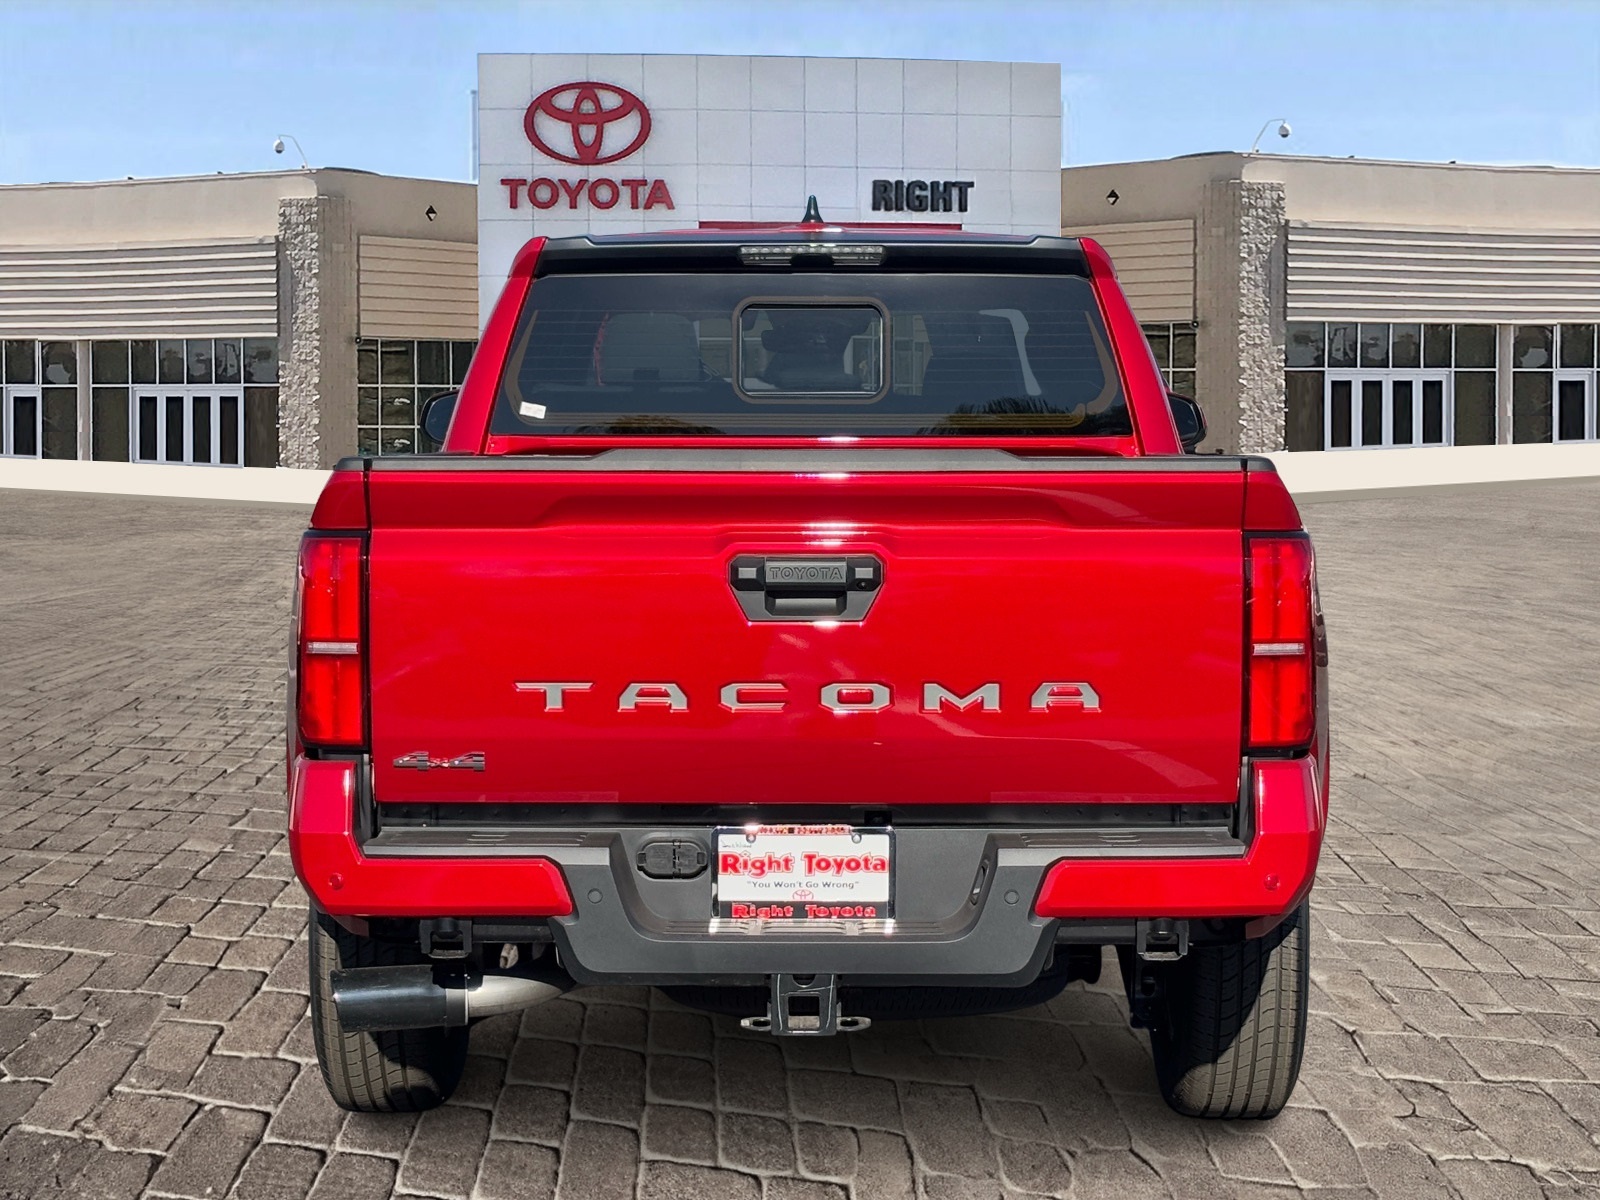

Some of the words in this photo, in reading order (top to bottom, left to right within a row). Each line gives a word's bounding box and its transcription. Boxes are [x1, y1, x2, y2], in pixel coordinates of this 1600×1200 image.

[500, 178, 675, 210] TOYOTA
[872, 179, 975, 213] RIGHT
[769, 566, 843, 580] TOYOTA
[512, 681, 1102, 713] TACOMA
[718, 851, 795, 879] Right
[801, 852, 889, 877] Toyota
[731, 902, 794, 919] Right
[805, 904, 876, 919] Toyota
